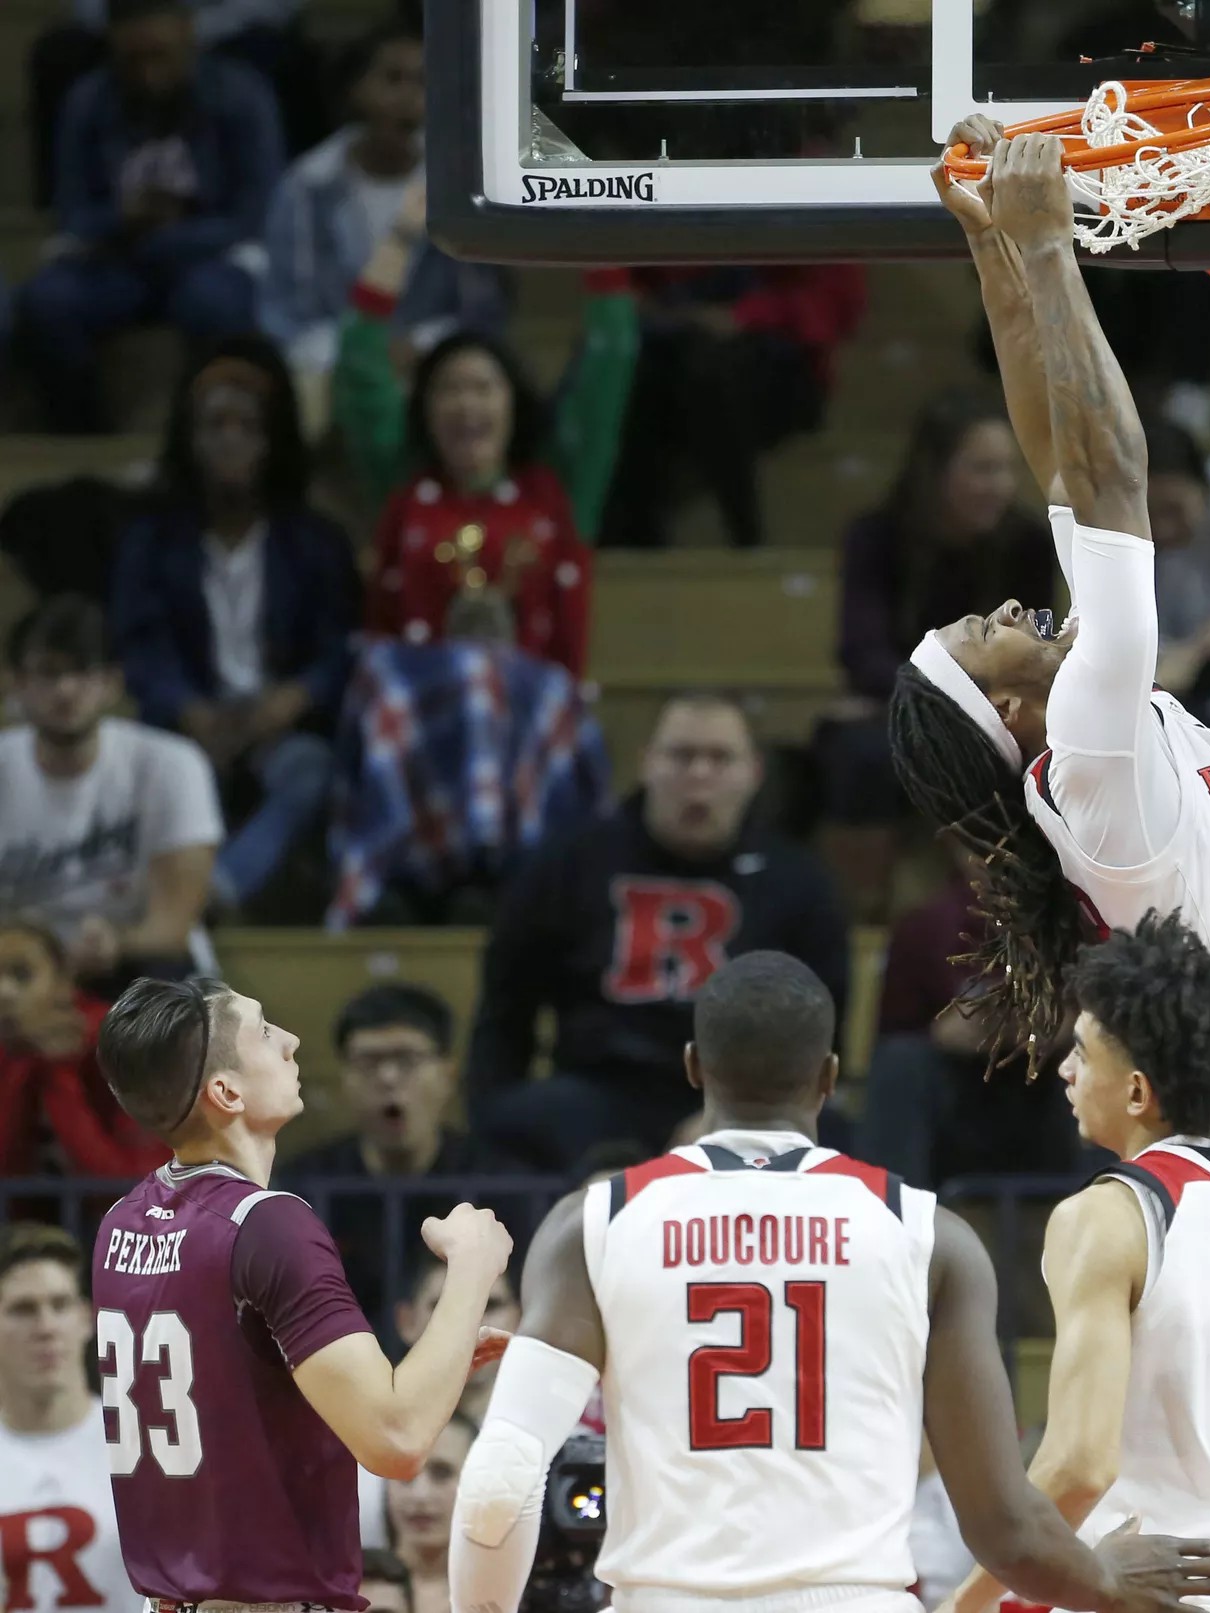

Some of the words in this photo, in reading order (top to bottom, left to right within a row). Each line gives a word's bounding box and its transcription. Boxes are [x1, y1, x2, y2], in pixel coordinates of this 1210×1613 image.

[522, 172, 653, 204] SPALDING
[605, 877, 742, 1002] R
[103, 1228, 187, 1275] PEKAREK
[663, 1213, 850, 1268] DOUCOURE
[96, 1307, 204, 1479] 33
[686, 1280, 826, 1451] 21
[0, 1505, 107, 1611] R
